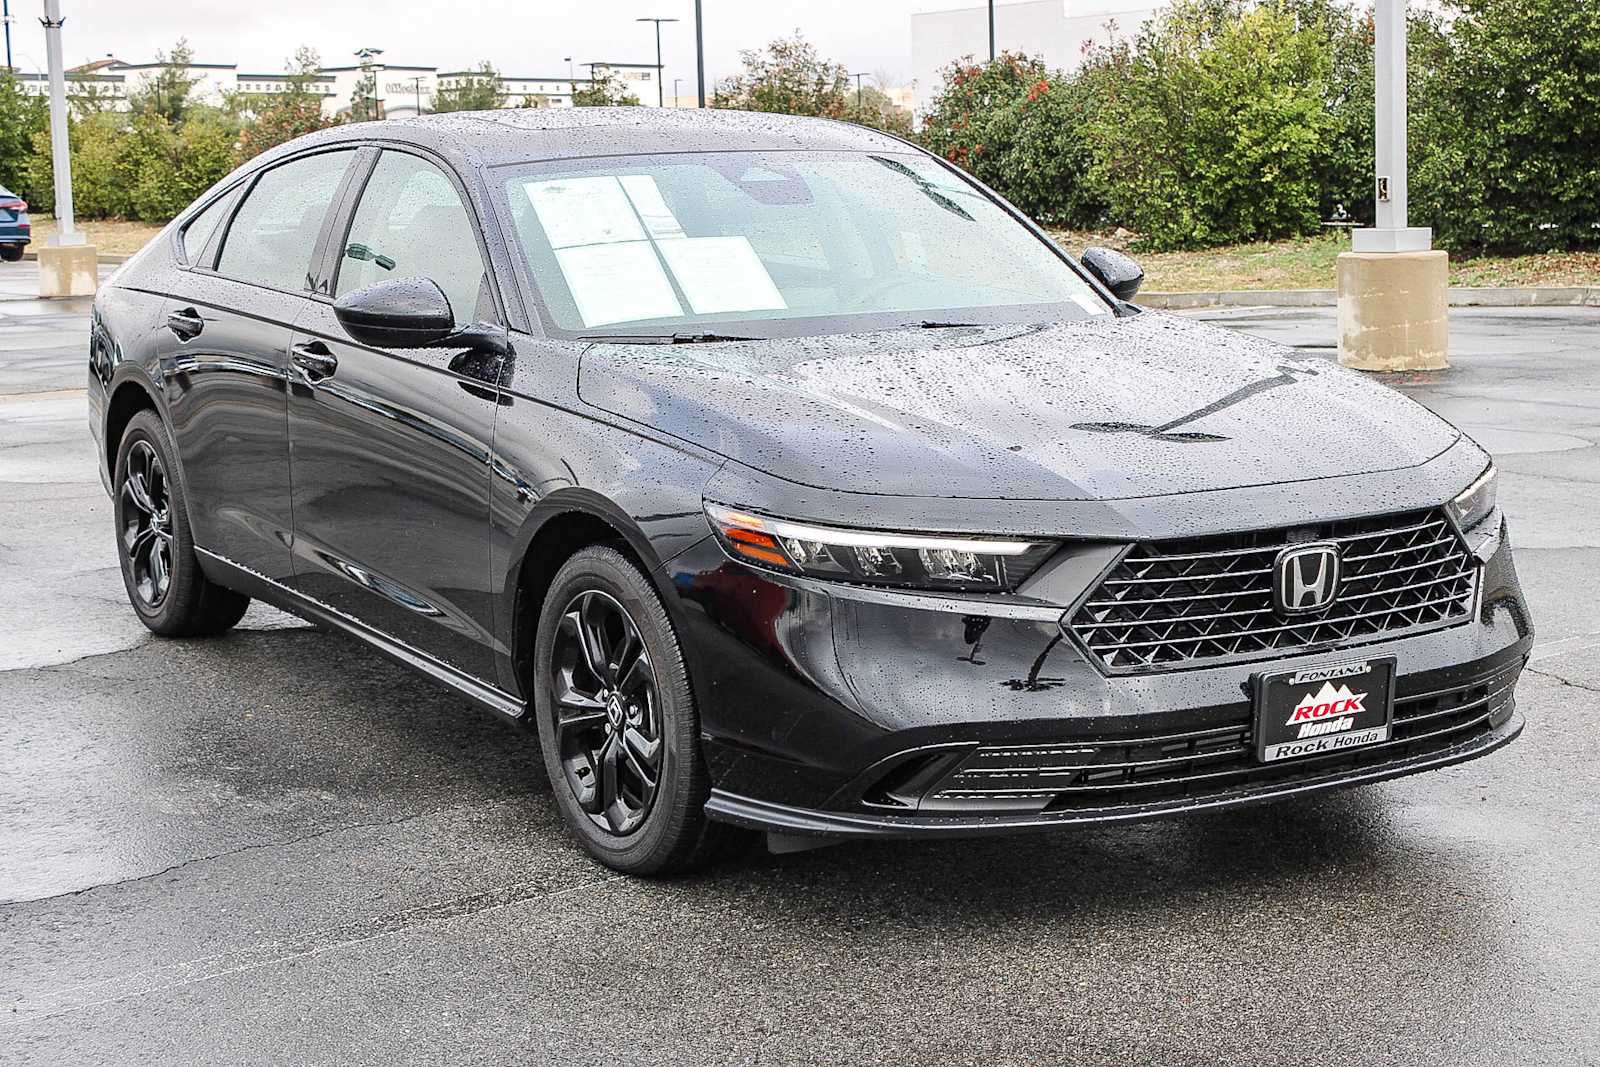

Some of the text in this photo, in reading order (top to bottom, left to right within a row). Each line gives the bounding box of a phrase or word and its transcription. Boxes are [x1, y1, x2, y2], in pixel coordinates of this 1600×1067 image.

[1299, 665, 1364, 682] FONTANA
[1294, 697, 1362, 721] ROCK
[1297, 716, 1355, 739] Honda
[1275, 731, 1378, 758] Rock Honda
